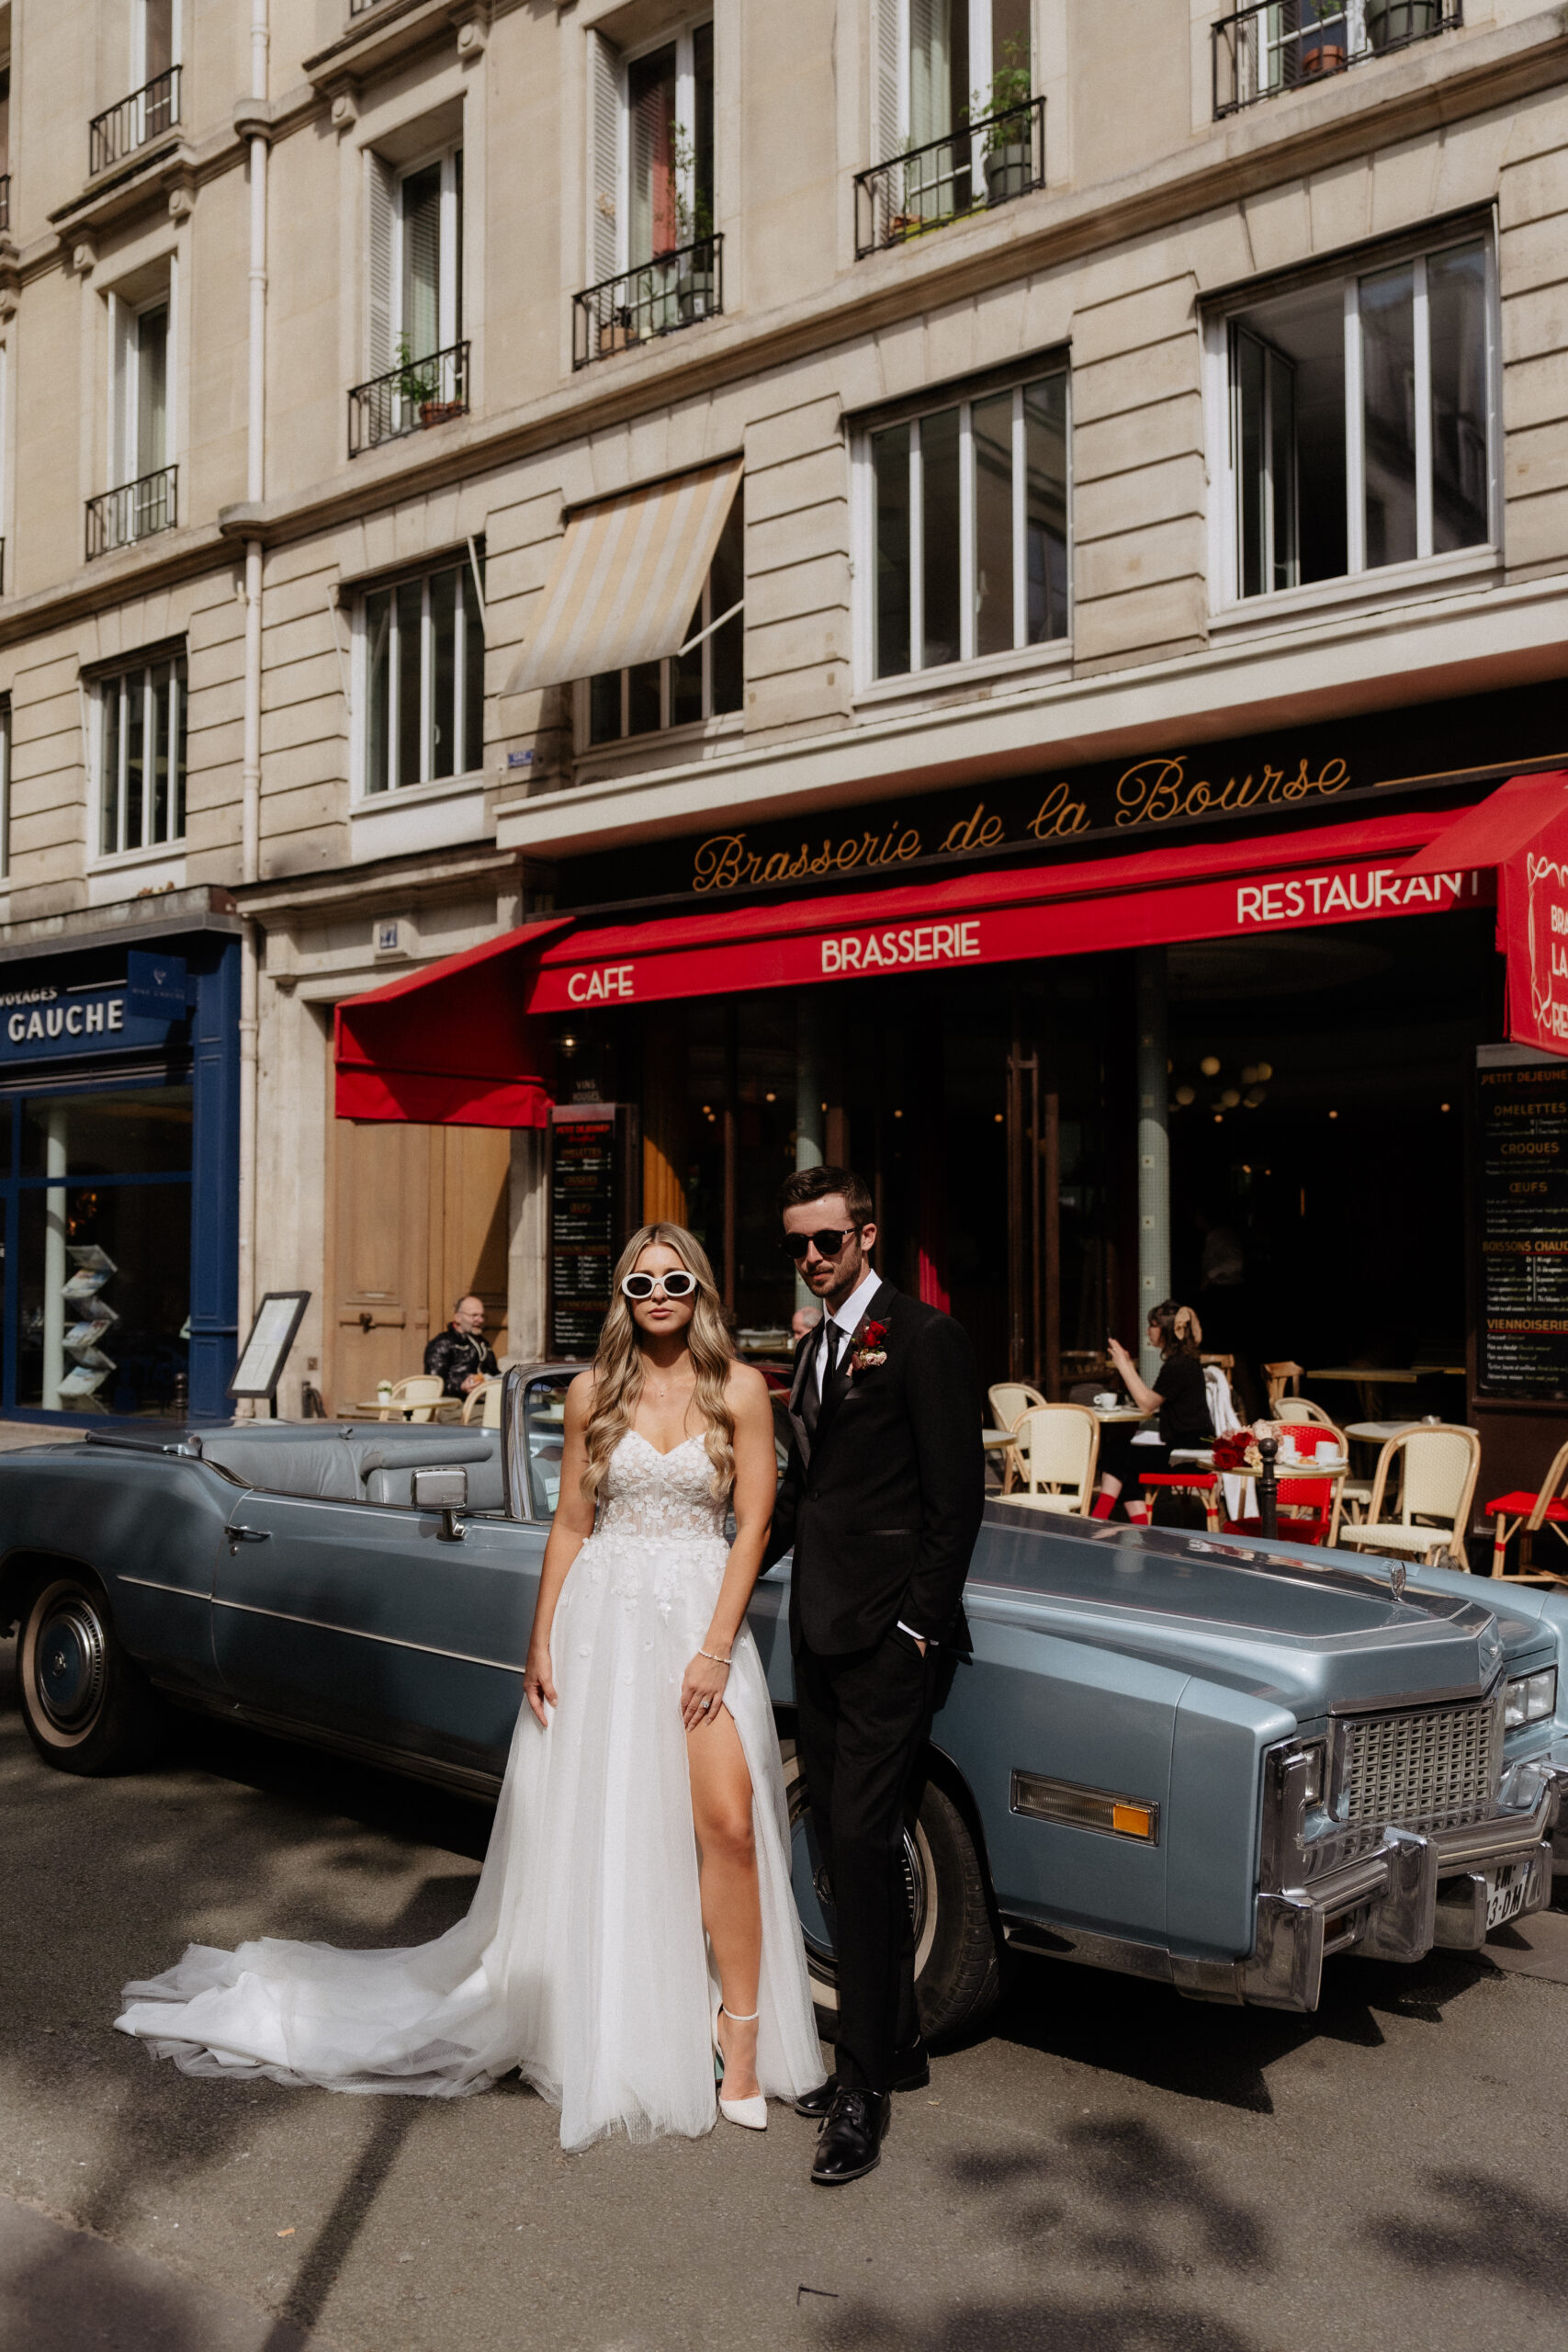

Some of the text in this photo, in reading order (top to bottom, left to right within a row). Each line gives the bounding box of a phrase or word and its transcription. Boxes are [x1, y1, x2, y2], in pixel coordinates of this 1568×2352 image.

[693, 756, 1350, 892] Brasserie de la Bourse
[821, 922, 980, 973] BRASSERIE
[568, 966, 634, 1002] CAFE
[8, 1000, 123, 1042] GAUCHE
[1494, 1102, 1567, 1115] OMELETTES
[1500, 1142, 1560, 1155] CROQUES
